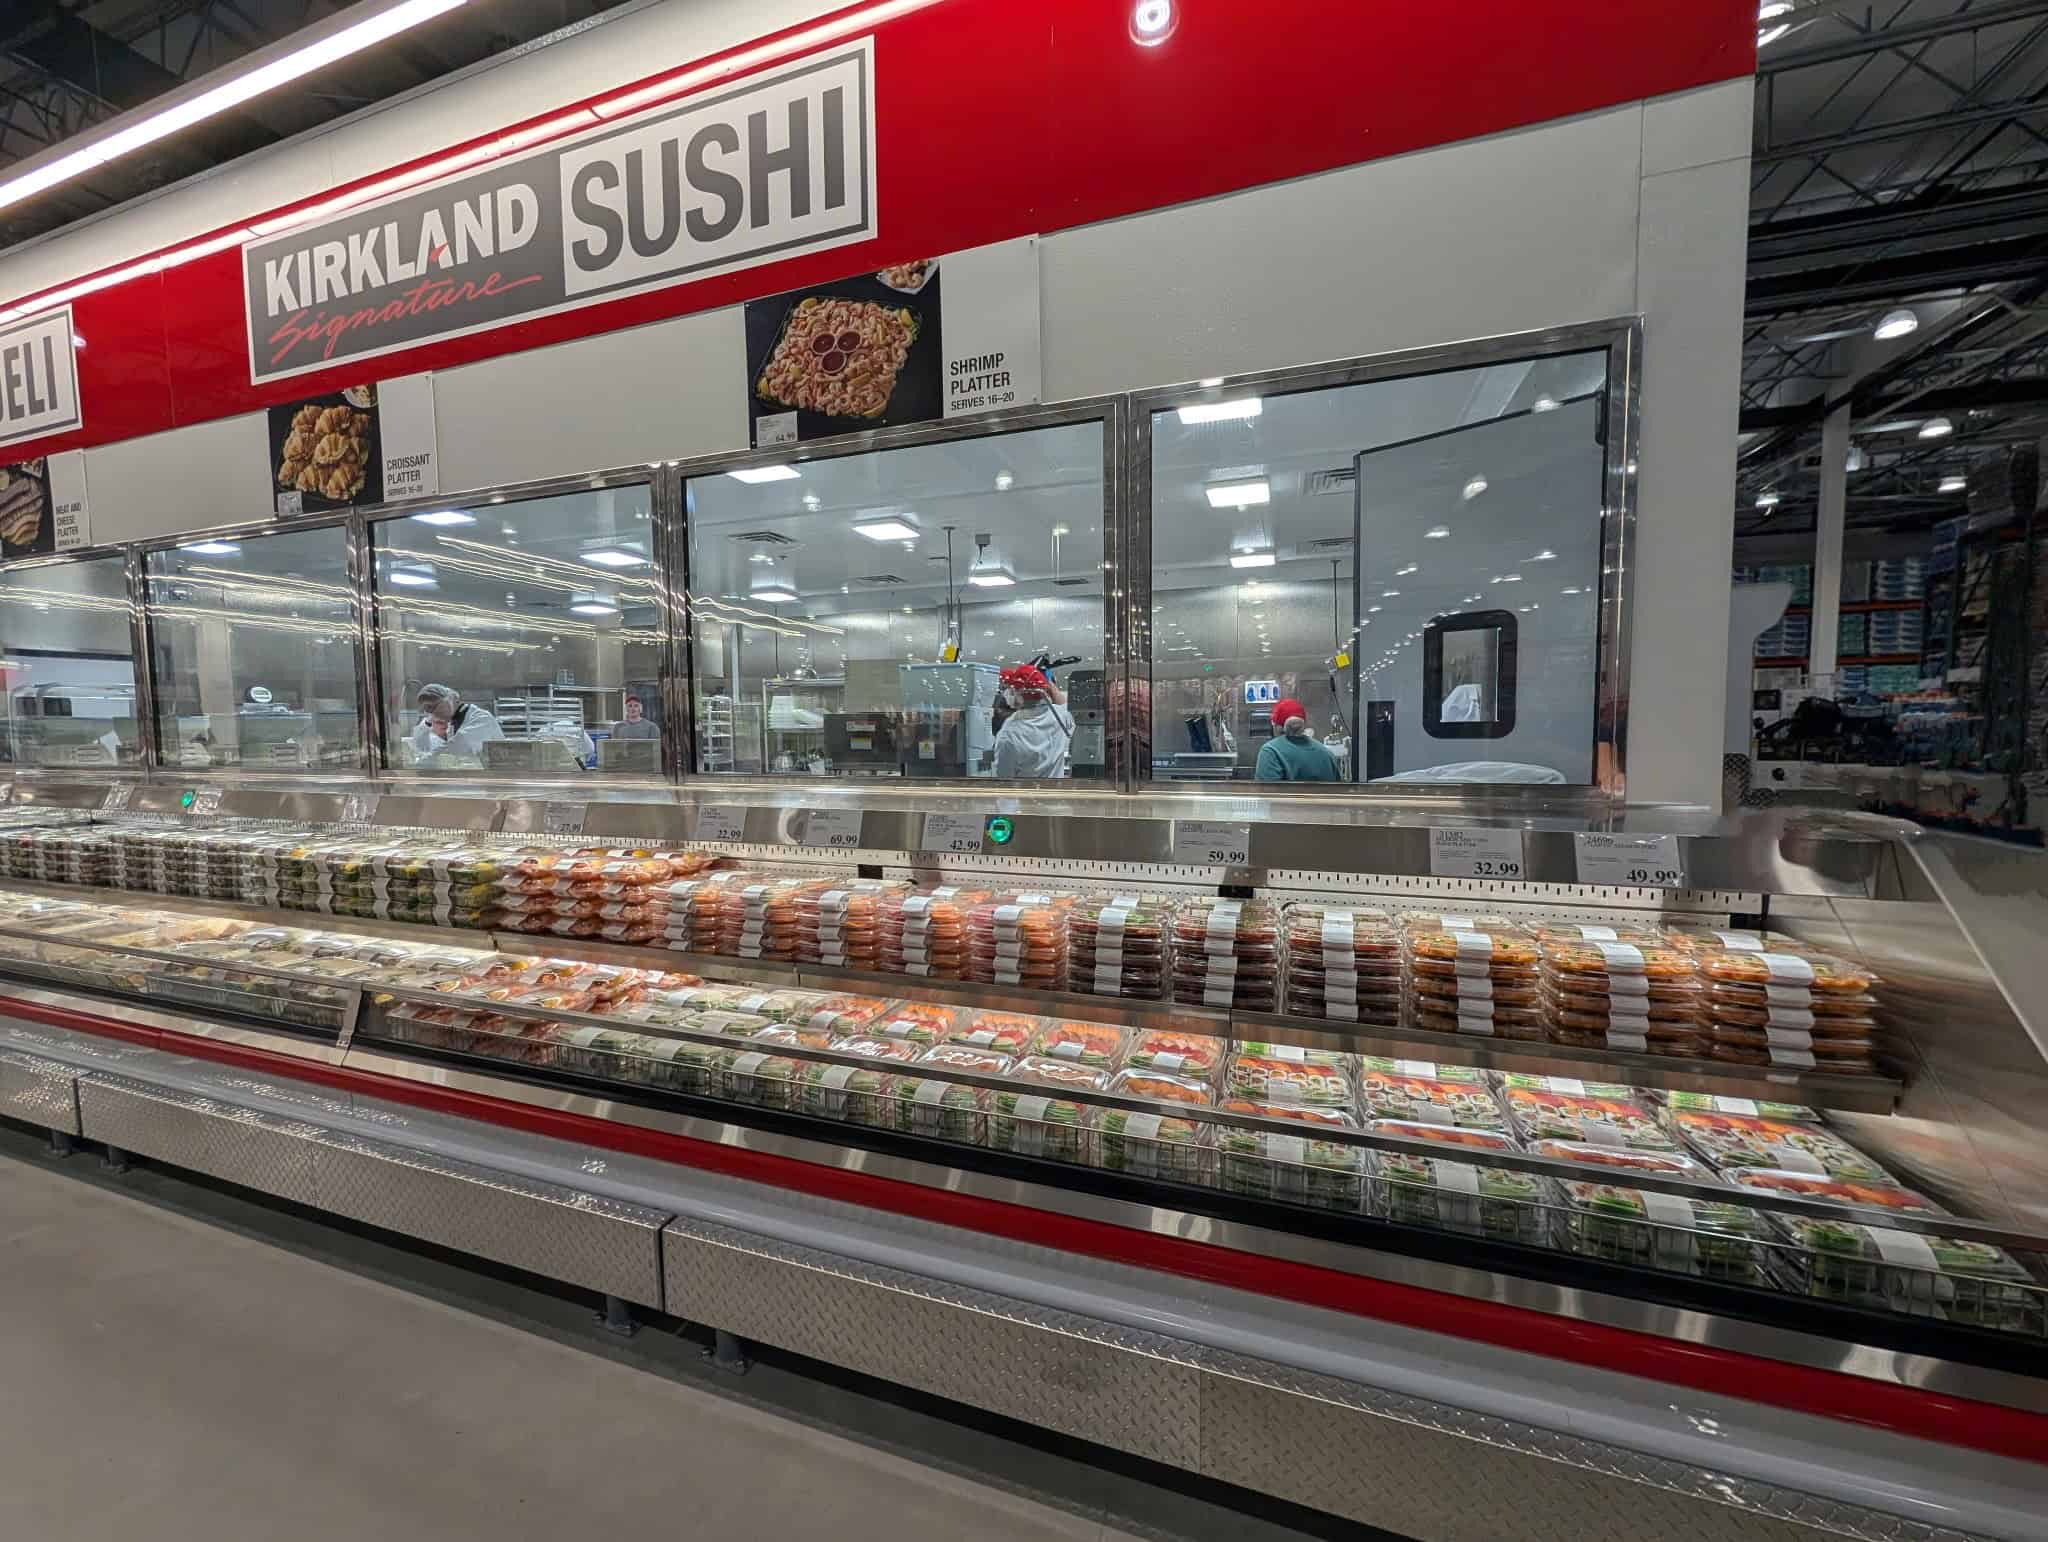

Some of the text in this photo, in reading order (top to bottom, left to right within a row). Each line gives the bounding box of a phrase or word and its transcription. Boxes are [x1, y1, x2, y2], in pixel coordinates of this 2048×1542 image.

[571, 86, 846, 272] SUSHI
[264, 183, 540, 317] KIRKLAND
[267, 271, 543, 365] Signature
[950, 352, 1004, 376] SHRIMP
[0, 335, 58, 420] ELI
[951, 371, 1010, 395] PLATTER
[951, 396, 985, 411] SERVES
[386, 453, 431, 471] CROISSANT
[387, 470, 421, 485] PLATTER
[718, 829, 742, 839] 22.99
[830, 834, 857, 845] 69.99
[949, 839, 980, 852] 42.99
[1208, 850, 1245, 863] 59.99
[1473, 862, 1519, 875] 32.99
[1627, 869, 1677, 884] 49.99
